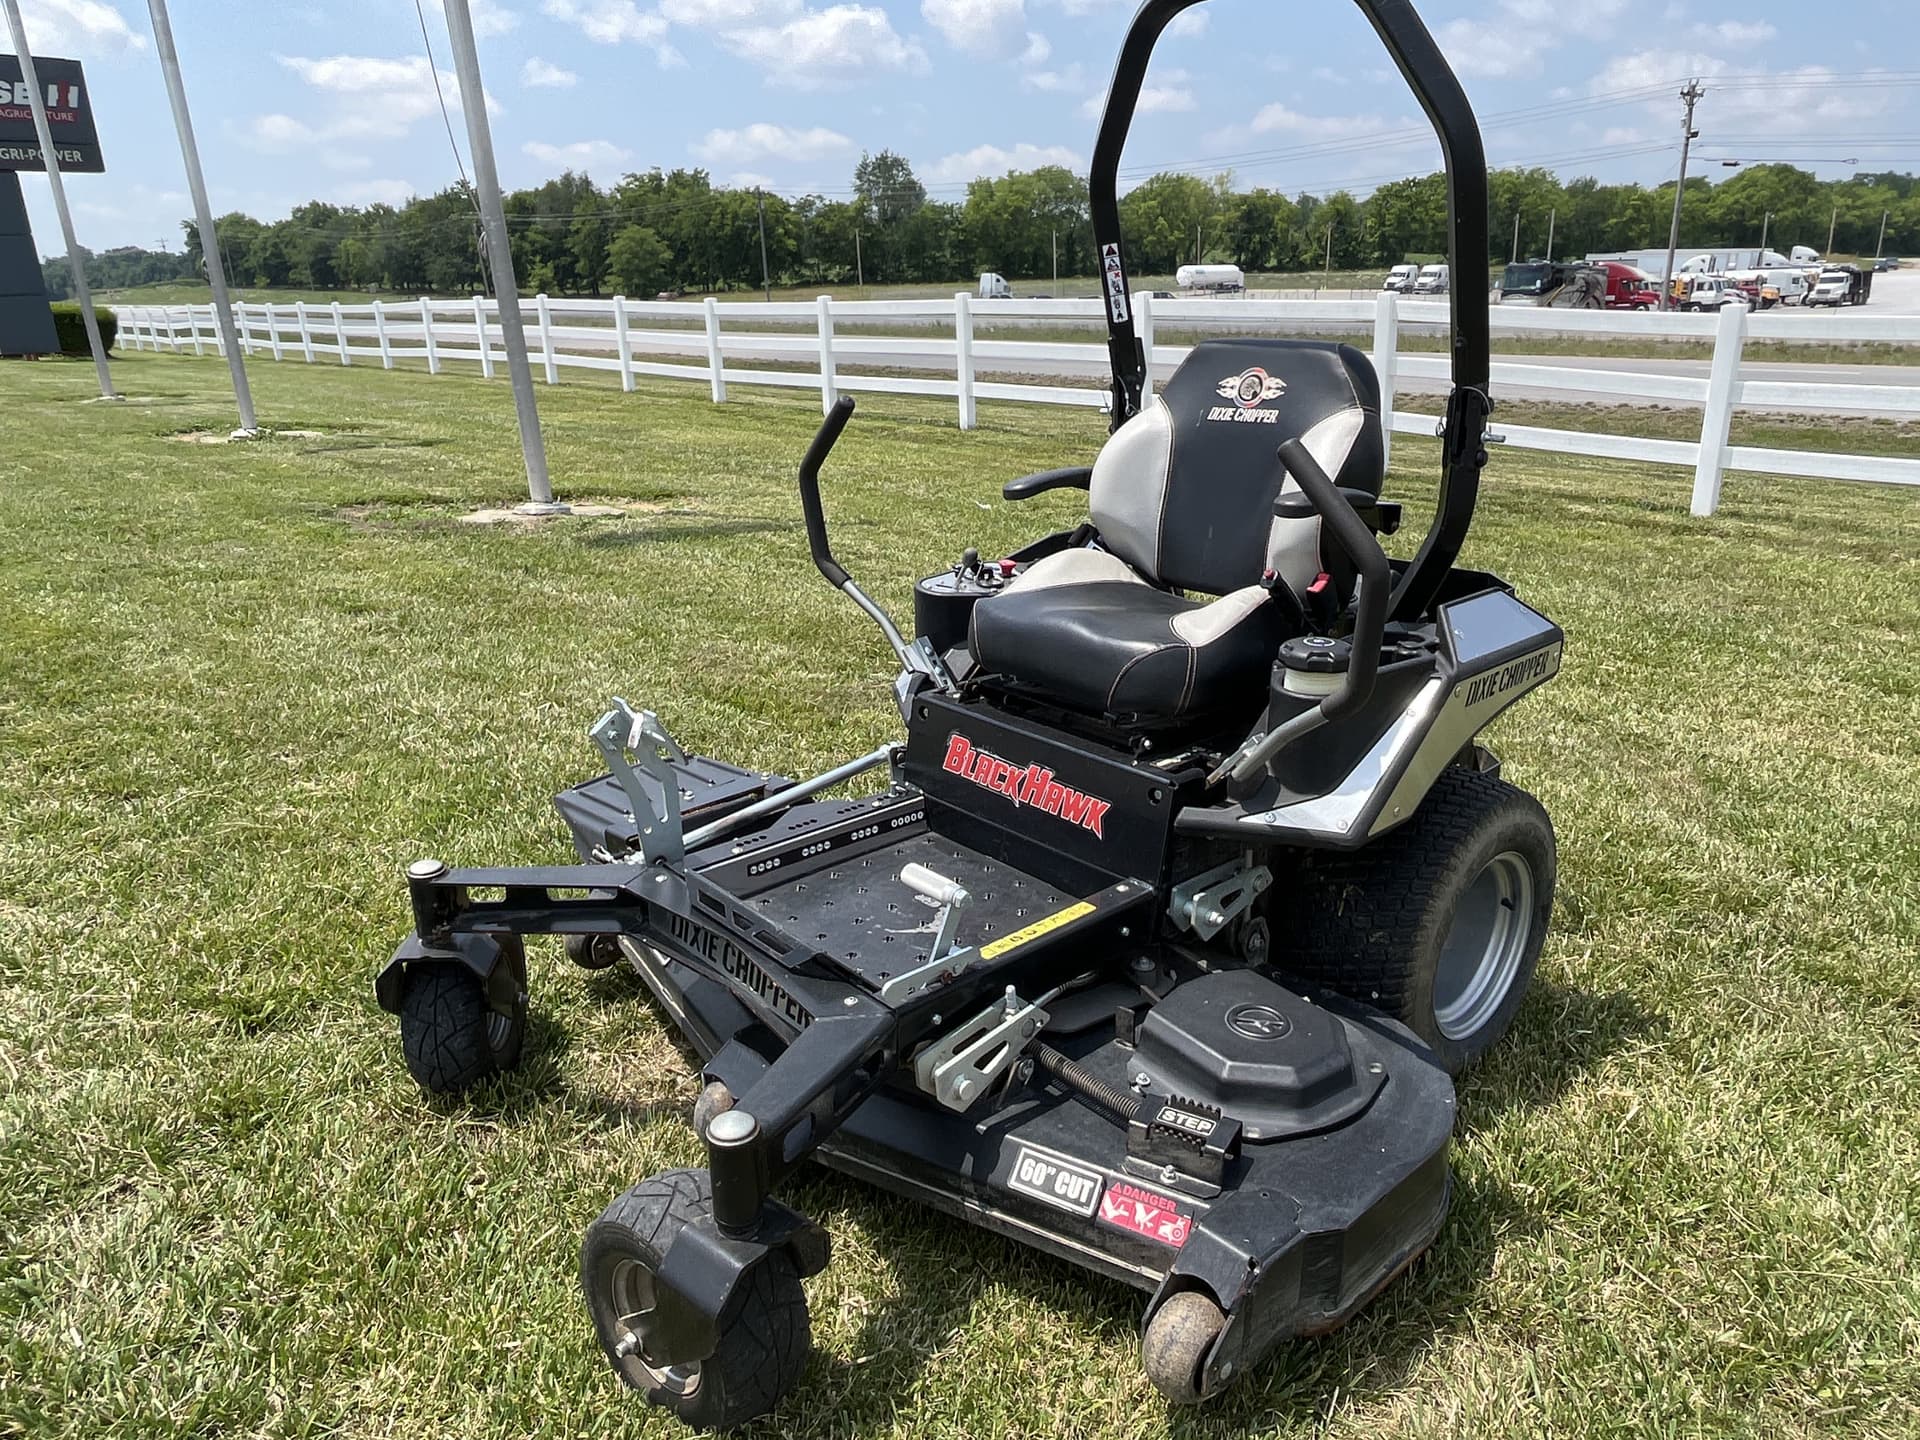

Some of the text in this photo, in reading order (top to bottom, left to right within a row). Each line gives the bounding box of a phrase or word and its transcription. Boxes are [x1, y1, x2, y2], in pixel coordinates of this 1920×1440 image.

[1207, 406, 1279, 424] DIXIE CHOPPER
[1464, 650, 1550, 708] DIXIE CHOPPER
[671, 914, 815, 1030] DIXIE CHOPPER
[1161, 1110, 1212, 1132] STEP
[1053, 1171, 1095, 1204] CUT
[1124, 1184, 1177, 1211] DANGER
